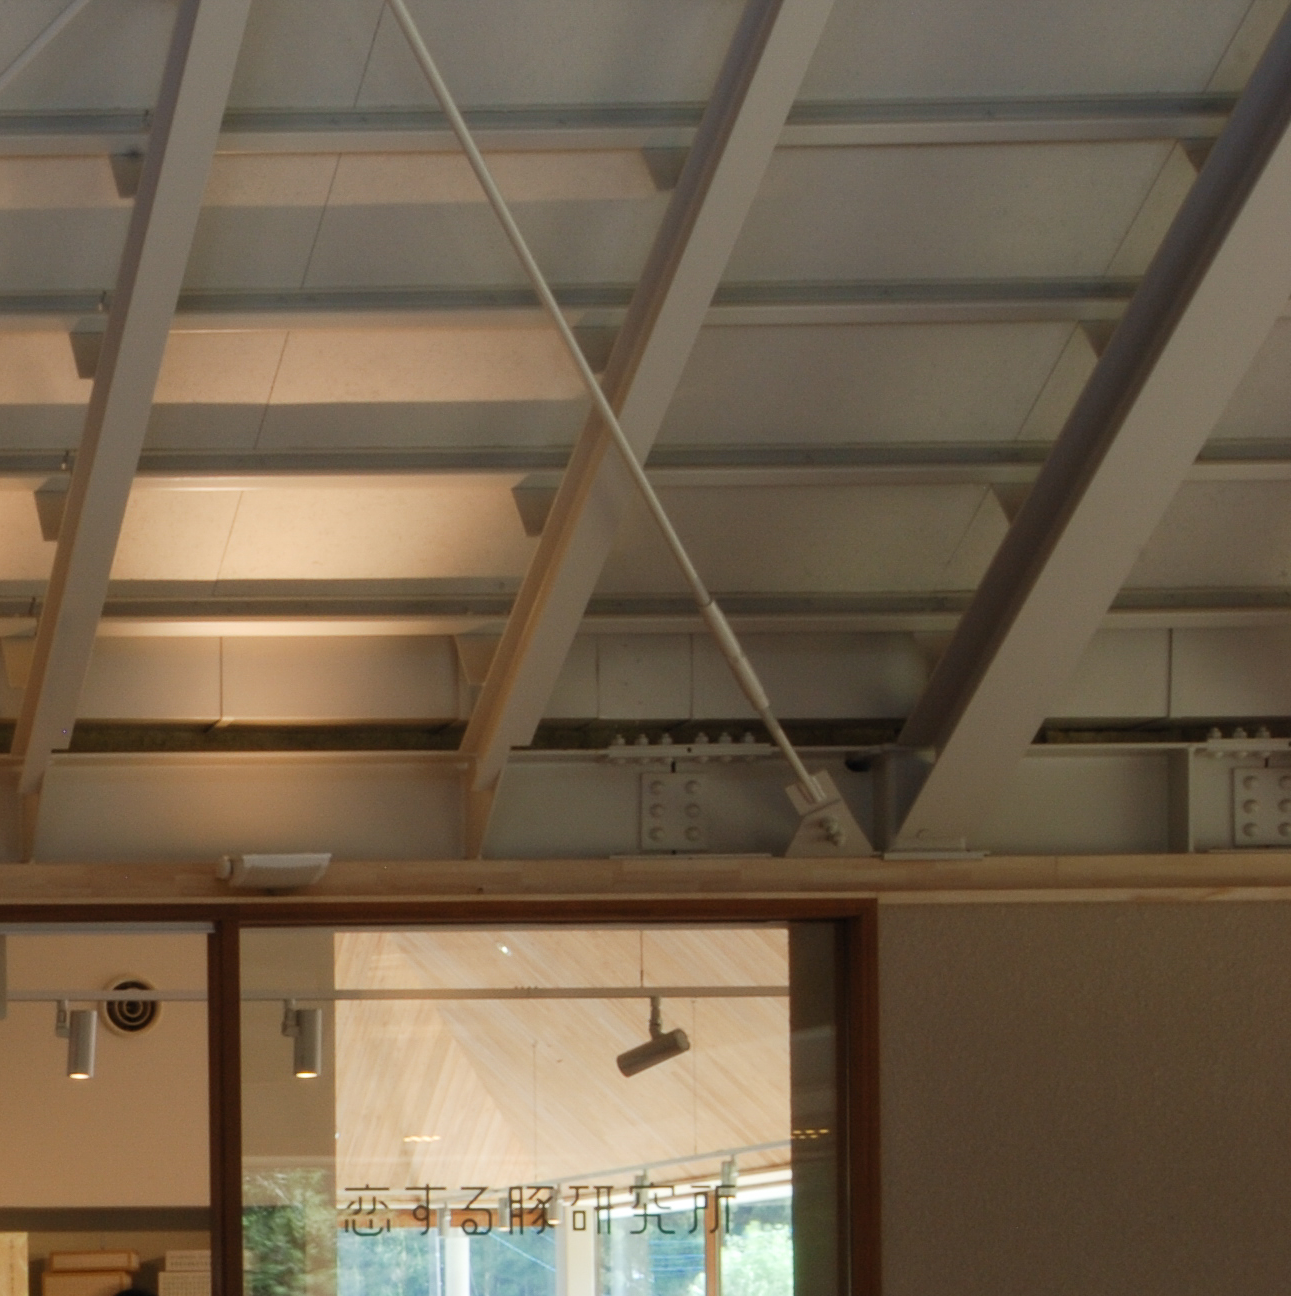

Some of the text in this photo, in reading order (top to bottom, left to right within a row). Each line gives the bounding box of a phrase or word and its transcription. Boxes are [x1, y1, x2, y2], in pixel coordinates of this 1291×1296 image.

[344, 1183, 736, 1236] 恋する豚研究所
